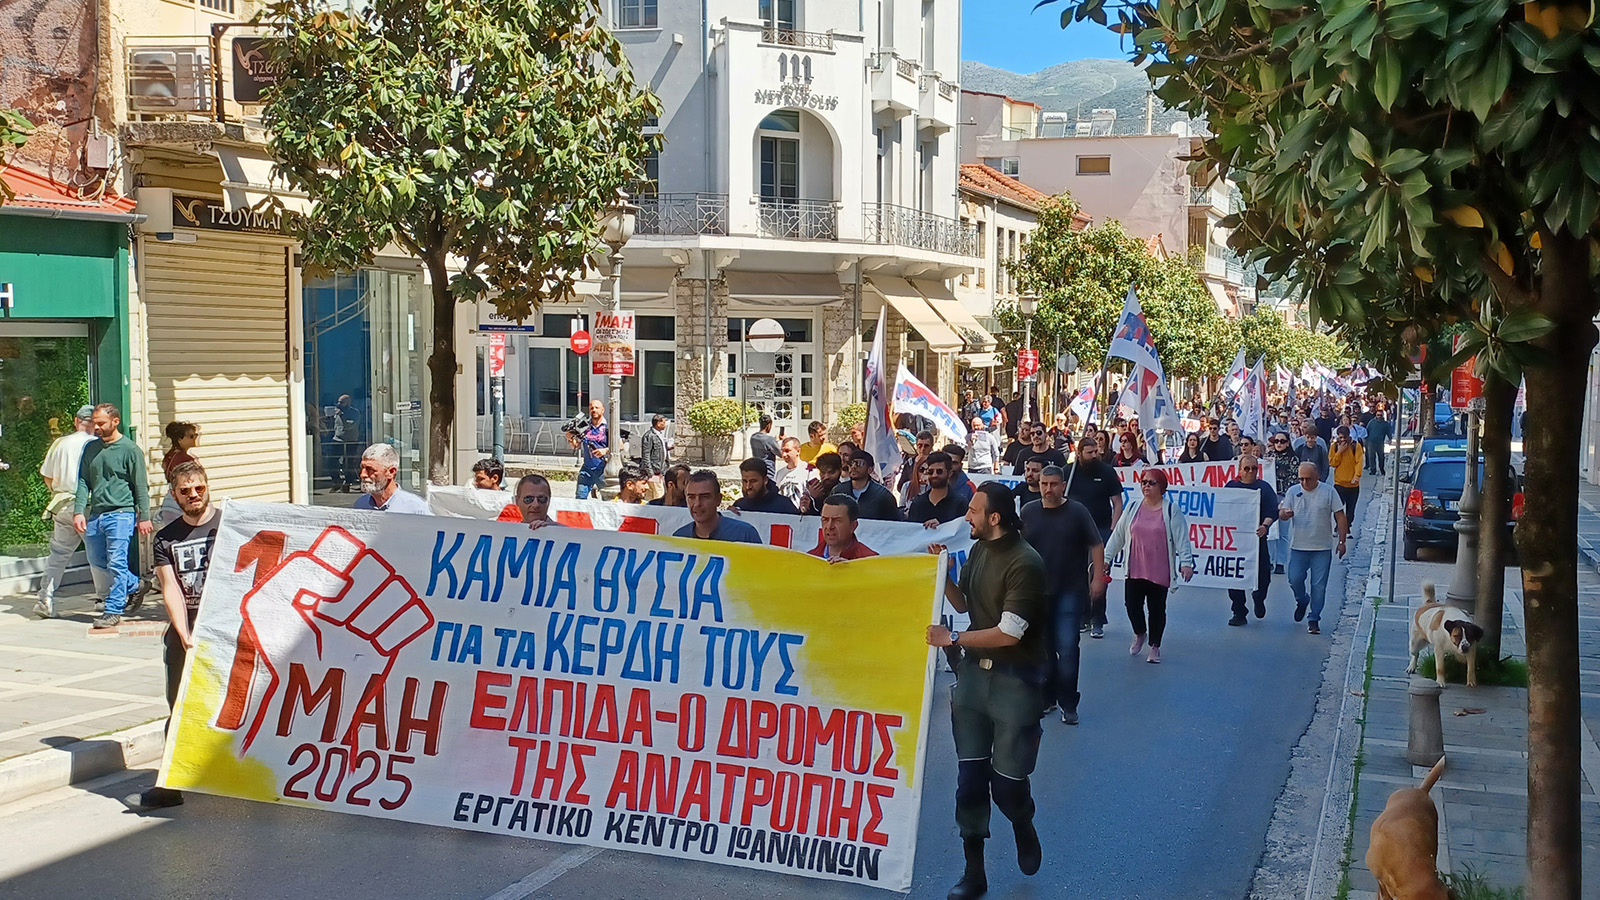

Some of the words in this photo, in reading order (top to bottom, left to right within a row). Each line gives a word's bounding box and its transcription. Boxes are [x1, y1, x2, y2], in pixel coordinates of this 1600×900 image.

[754, 89, 839, 111] METROPOLIS
[426, 531, 581, 610] ΚΑΜΙΑ
[593, 546, 724, 622] ΘΥΣΙΑ
[431, 621, 483, 665] ΓΙΑ
[494, 628, 535, 670] ΤΑ
[543, 612, 685, 683] ΚΕΡΔΗ
[700, 625, 804, 696] ΤΟΥΣ
[276, 662, 449, 756] ΜΑΗ
[717, 697, 902, 780] ΔΡΟΜΟΣ
[283, 743, 416, 810] 2025
[508, 736, 597, 805] ΤΗΣ
[605, 750, 895, 846] ΑΝΑΤΡΟΠΗΣ
[453, 791, 593, 838] ΕΡΓΑΤΙΚΟ
[603, 811, 719, 855] ΚΕΝΤΡΟ
[727, 825, 882, 881] ΙΩΑΝΝΙΝΩΝ
